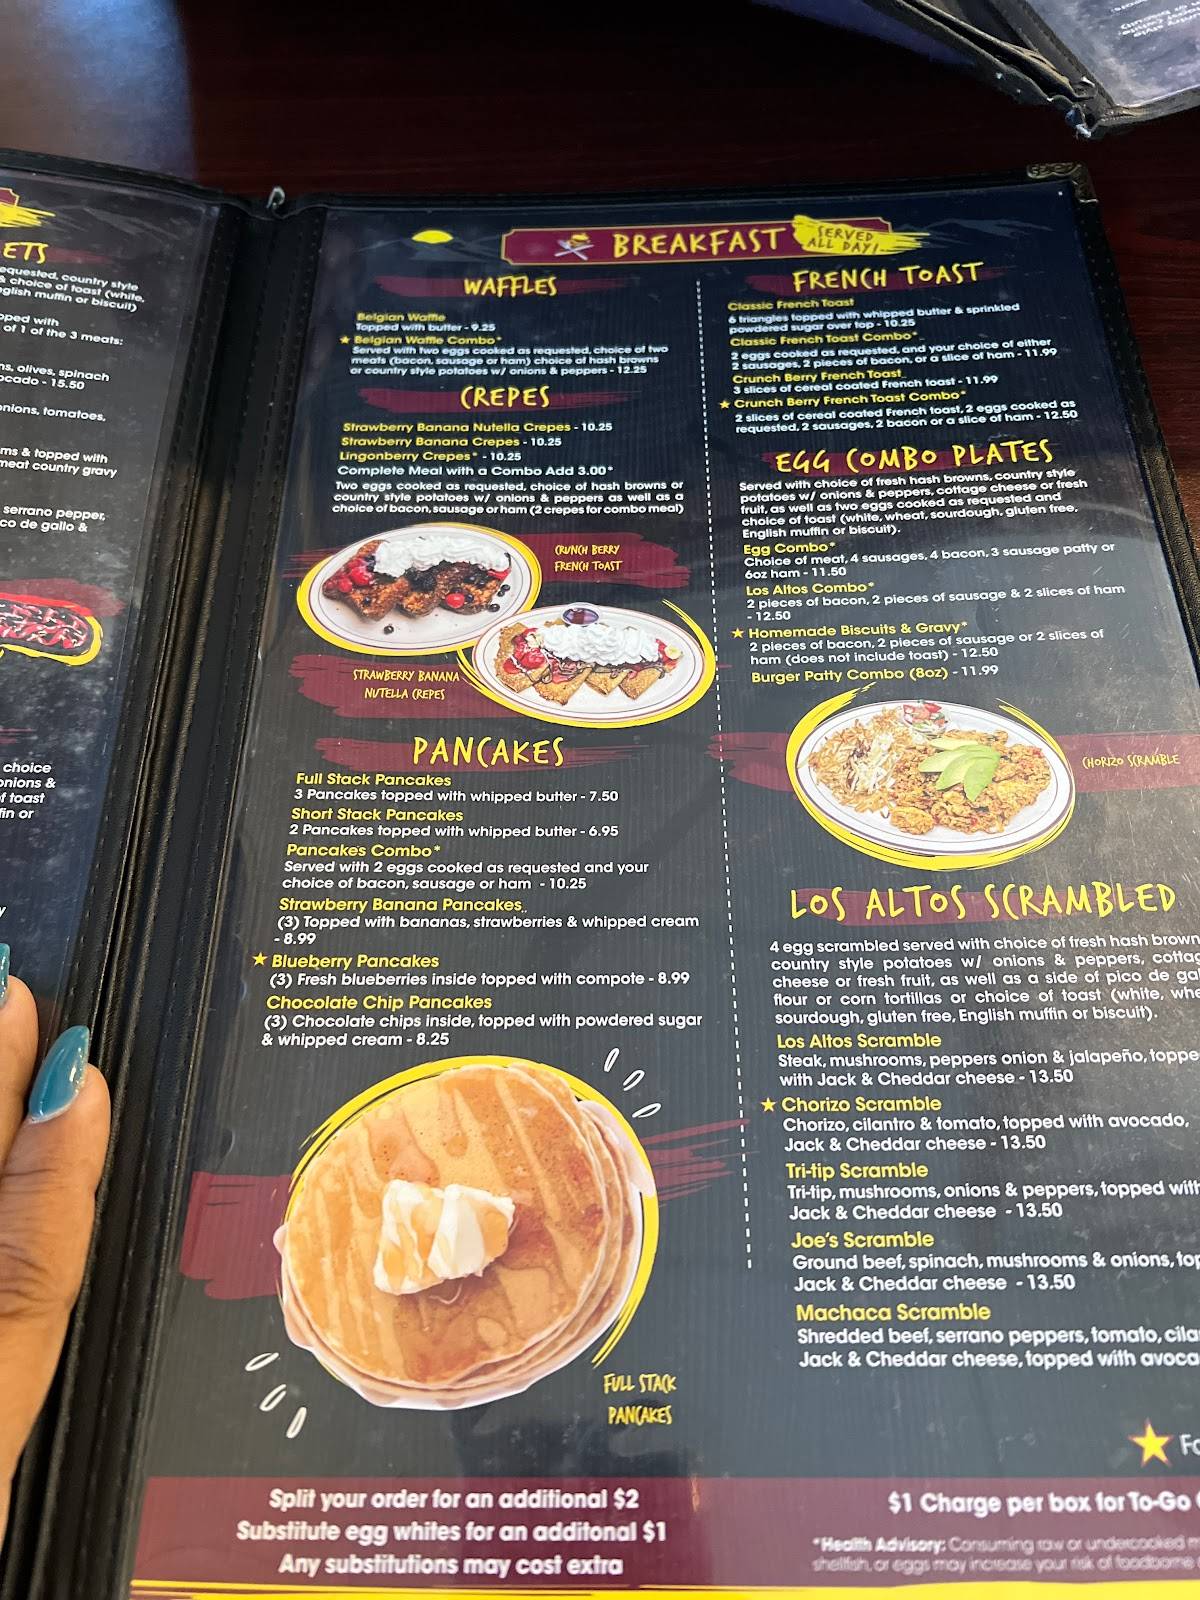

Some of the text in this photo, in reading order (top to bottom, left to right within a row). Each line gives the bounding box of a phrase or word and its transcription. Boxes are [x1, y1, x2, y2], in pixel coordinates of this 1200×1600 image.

[818, 225, 873, 242] SERVED
[613, 228, 786, 258] BREAKFAST
[807, 238, 879, 253] ALL DAY!
[61, 274, 138, 291] country style
[792, 261, 983, 292] FRENCH TOAST
[10, 277, 52, 288] choice
[70, 284, 101, 295] toast
[104, 289, 144, 303] (white,
[463, 275, 557, 297] WAFFLES
[34, 290, 72, 302] muffin
[91, 297, 137, 312] biscuit)
[727, 297, 854, 311] Classic French Toast
[355, 312, 446, 323] Belgian Waffle
[355, 322, 399, 332] Topped
[400, 323, 425, 331] with
[427, 323, 462, 331] butter
[470, 323, 496, 331] 9.25
[353, 335, 402, 345] Belgian
[405, 335, 443, 344] Waffle
[16, 364, 109, 381] olives, spinach
[51, 377, 84, 389] 15.50
[460, 385, 552, 409] CREPES
[733, 398, 783, 408] Crunch
[786, 397, 820, 407] Berry
[823, 394, 868, 404] French
[869, 393, 905, 402] Toast
[42, 406, 105, 421] tomatoes,
[342, 422, 413, 433] Strawberry
[417, 422, 469, 431] Banana
[472, 422, 519, 431] Nutella
[523, 422, 570, 433] Crepes
[581, 422, 612, 431] 10.25
[339, 451, 419, 462] Lingonberry
[489, 451, 522, 461] 10.25
[776, 438, 1054, 473] EGG COMBO PLATES
[0, 459, 117, 478] meat country gravy
[337, 465, 404, 476] Complete
[408, 465, 442, 475] Meal
[445, 466, 474, 475] with
[477, 467, 487, 475] a
[490, 466, 542, 475] Combo
[544, 466, 573, 475] Add
[2, 505, 106, 521] serrano pepper,
[554, 544, 620, 555] CRUNCH BERRY
[743, 544, 770, 556] Egg
[554, 560, 623, 572] FRENCH TOAST
[746, 585, 769, 595] Los
[772, 584, 808, 595] Altos
[748, 625, 836, 638] Homemade
[840, 623, 896, 635] Biscuits
[900, 622, 911, 633] &
[353, 668, 459, 682] STRAWBERRY BANANA
[751, 671, 800, 684] Burger
[804, 669, 842, 682] Patty
[846, 668, 904, 680] Combo
[909, 666, 948, 681] (8oz)
[960, 664, 998, 676] 11.99
[364, 687, 445, 700] NUTELLA CREPES
[413, 736, 563, 768] PANCAKES
[2, 761, 51, 773] choice
[1081, 753, 1180, 769] CHORIZO SCRAMBLE
[296, 772, 451, 786] Full Stack Pancakes
[9, 792, 45, 803] toast
[293, 788, 303, 799] 3
[306, 788, 377, 800] Pancakes
[380, 789, 433, 802] topped
[436, 790, 466, 801] with
[469, 790, 531, 804] whipped
[535, 790, 577, 801] butter
[589, 790, 618, 801] 7.50
[286, 843, 366, 856] Pancakes
[790, 881, 1176, 921] LOS ALTOS SCRAMBLED
[271, 954, 439, 970] Blueberry Pancakes
[266, 994, 492, 1011] Chocolate Chip Pancakes
[777, 1032, 941, 1048] Los Altos Scramble
[778, 1048, 1145, 1068] Steak, mushrooms, peppers onion & jalapeño,
[781, 1095, 941, 1111] Chorizo Scramble
[784, 1137, 824, 1151] Jack
[829, 1137, 841, 1151] &
[845, 1136, 921, 1151] Cheddar
[925, 1136, 986, 1150] cheese
[1000, 1134, 1046, 1149] 13.50
[785, 1161, 928, 1181] Tri-tip Scramble
[843, 1230, 934, 1247] Scramble
[796, 1302, 991, 1321] Machaca Scramble
[603, 1373, 676, 1394] FULL STACK
[607, 1404, 672, 1425] PANCAKES
[887, 1490, 1191, 1516] $1 Charge per box for To-Go
[236, 1520, 665, 1543] Substitute egg whites for an additonal $1
[874, 1536, 946, 1554] Advisory:
[277, 1553, 623, 1577] Any substitutions may cost extra
